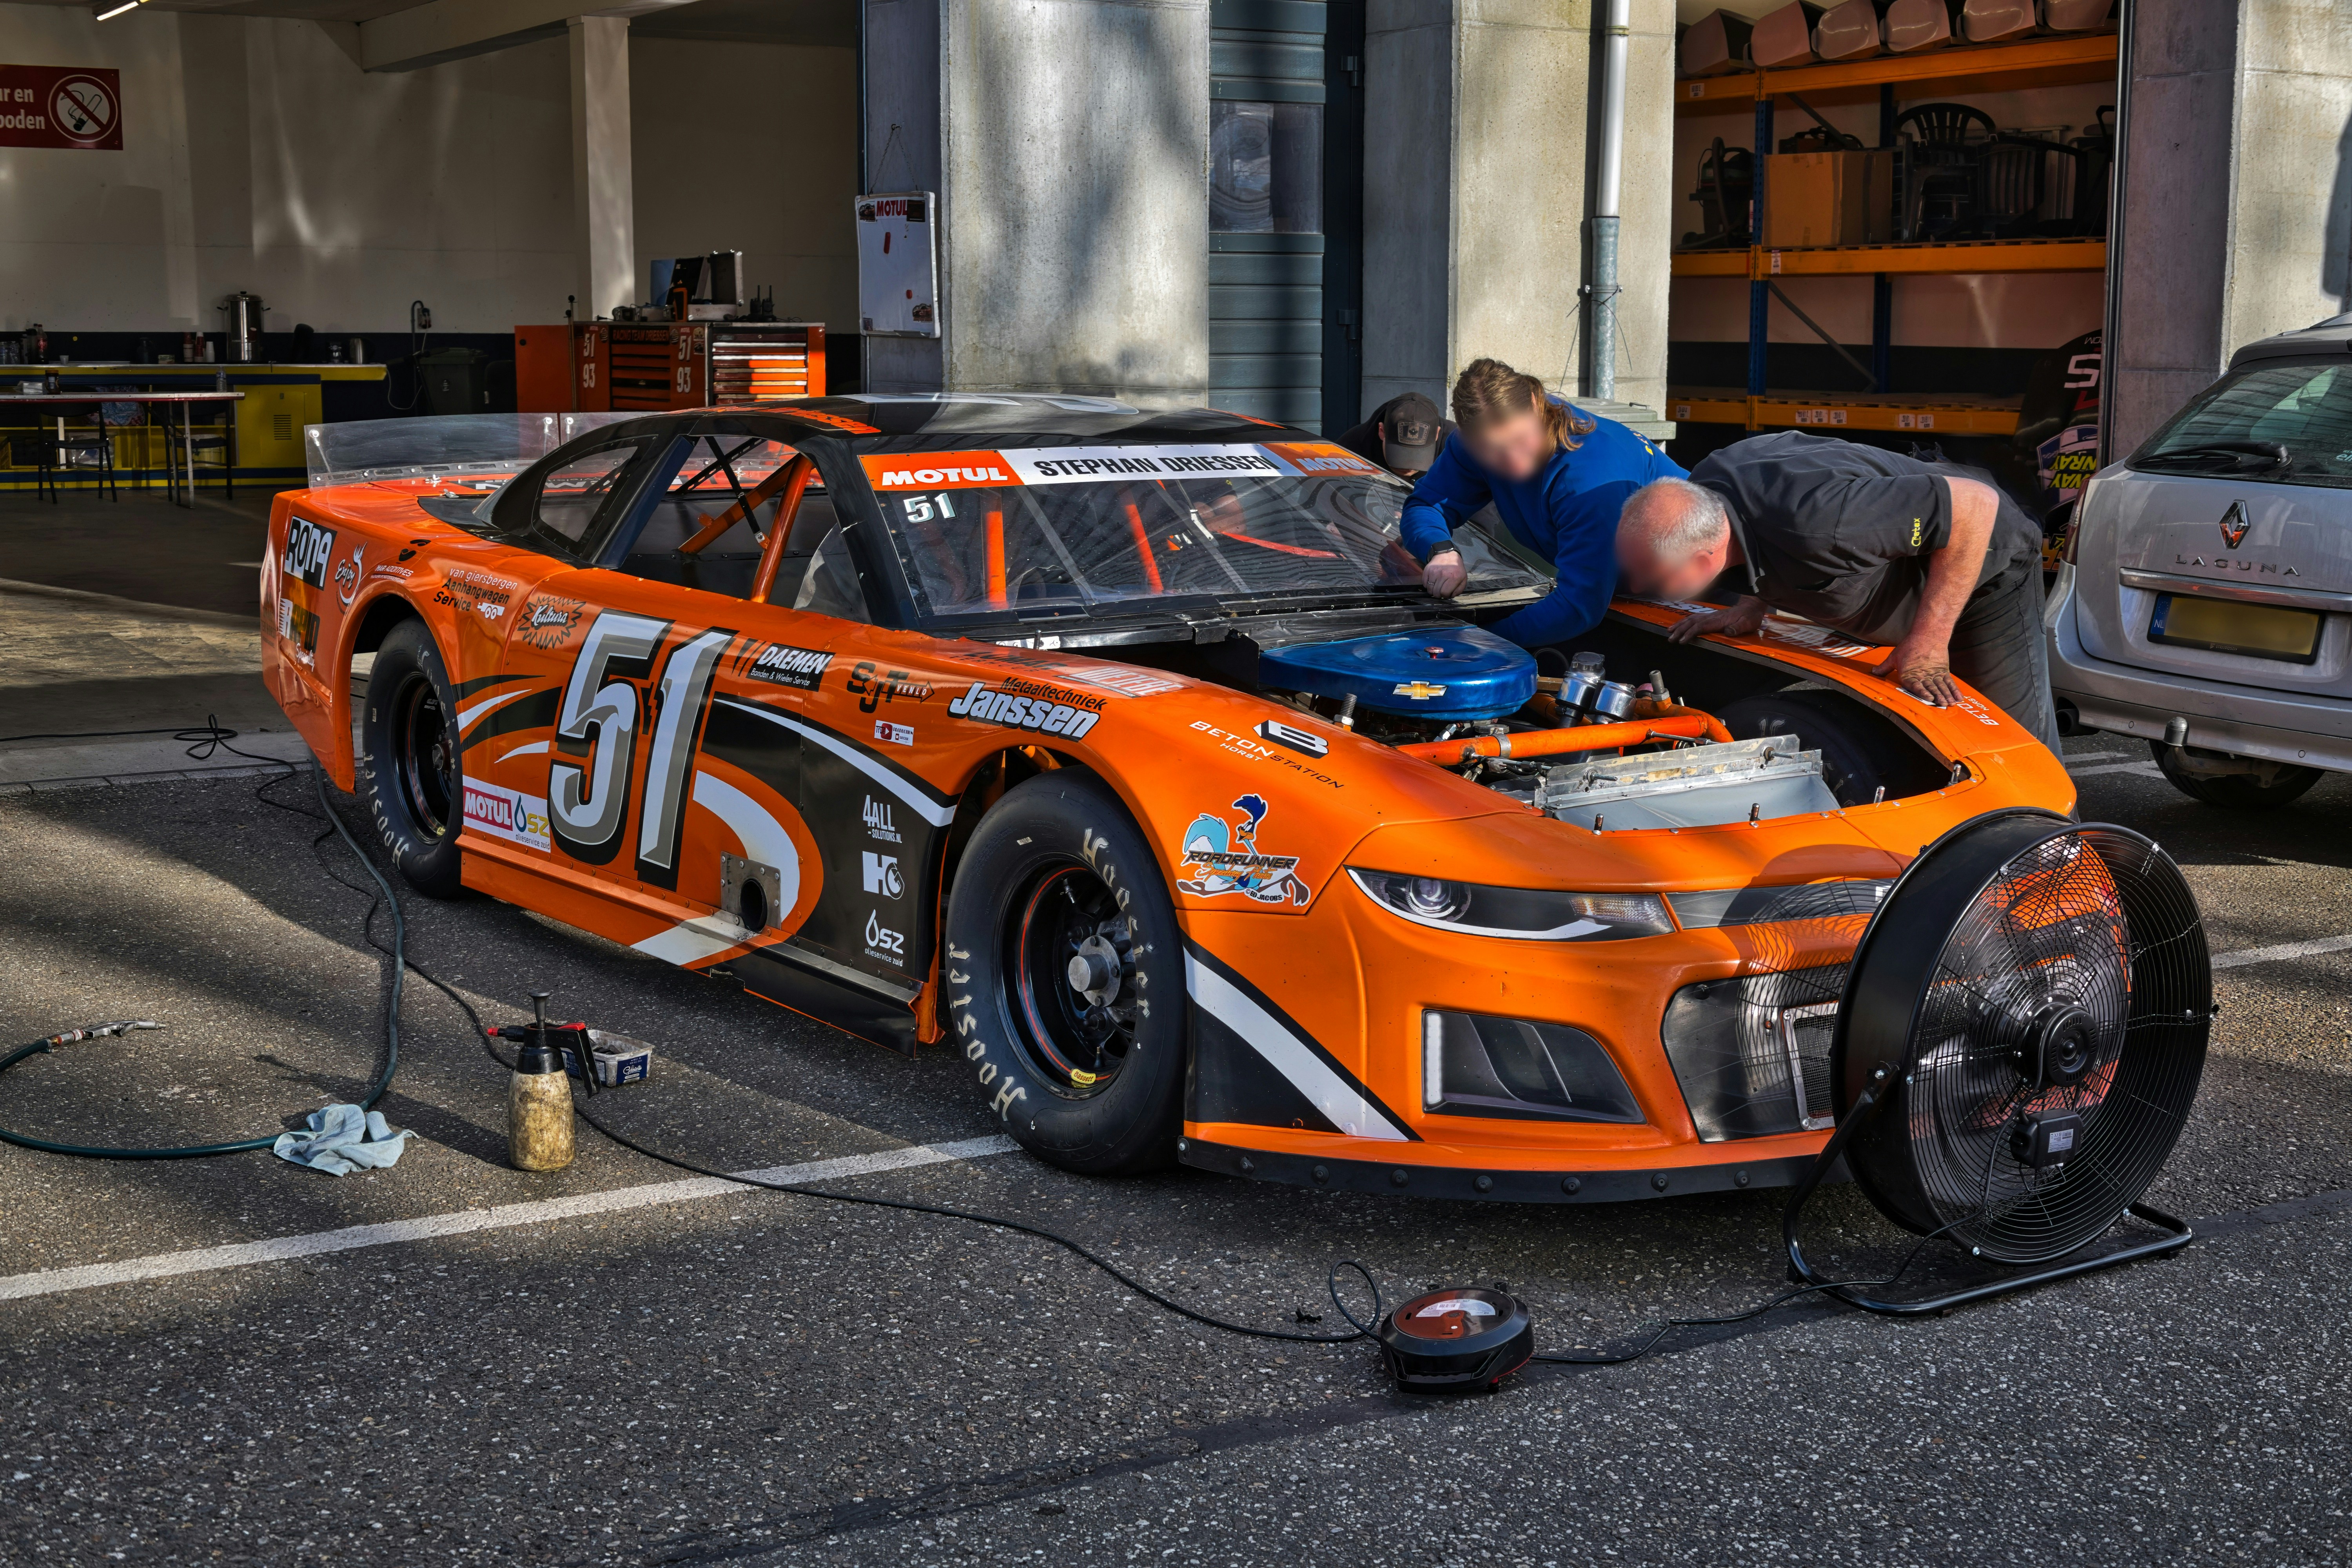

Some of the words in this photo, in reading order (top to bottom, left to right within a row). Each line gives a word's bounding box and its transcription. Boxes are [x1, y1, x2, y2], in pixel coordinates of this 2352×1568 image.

[14, 89, 34, 102] en
[876, 199, 907, 217] MOTUL
[583, 333, 595, 358] 51
[679, 335, 691, 361] 51
[583, 363, 595, 388] 93
[677, 367, 691, 393] 93
[1033, 458, 1163, 477] STEPHAN
[1157, 454, 1282, 472] DRIESSEN
[1296, 457, 1373, 471] MOTUL
[882, 467, 1008, 486] MOTUL
[903, 492, 956, 523] 51
[384, 565, 414, 577] ADDITIVES
[2175, 554, 2301, 577] LAGUNA
[442, 577, 510, 604] Aanhangwagen
[449, 568, 464, 579] van
[466, 570, 518, 591] giersbergen
[433, 591, 471, 612] Service
[531, 604, 568, 627] Kultura
[2154, 619, 2164, 629] NL
[757, 646, 833, 674] DAEMEN
[775, 673, 793, 683] Wielen
[897, 684, 927, 696] VENLO
[1001, 677, 1108, 711] Metaaltechniek
[948, 682, 1100, 740] Janssen
[1956, 701, 2000, 726] BETO
[548, 611, 735, 871] 51
[1220, 743, 1263, 761] HORST
[464, 791, 511, 826] MOTUL
[863, 795, 895, 831] 4ALL
[515, 834, 540, 847] olieservice
[541, 842, 550, 850] zuid
[1181, 850, 1298, 869] ROADRUNNER
[1196, 862, 1244, 884] Speedway
[1244, 864, 1278, 882] Photos
[865, 947, 892, 963] olieservice
[892, 956, 903, 967] zuid
[949, 941, 1027, 1122] Hoosier
